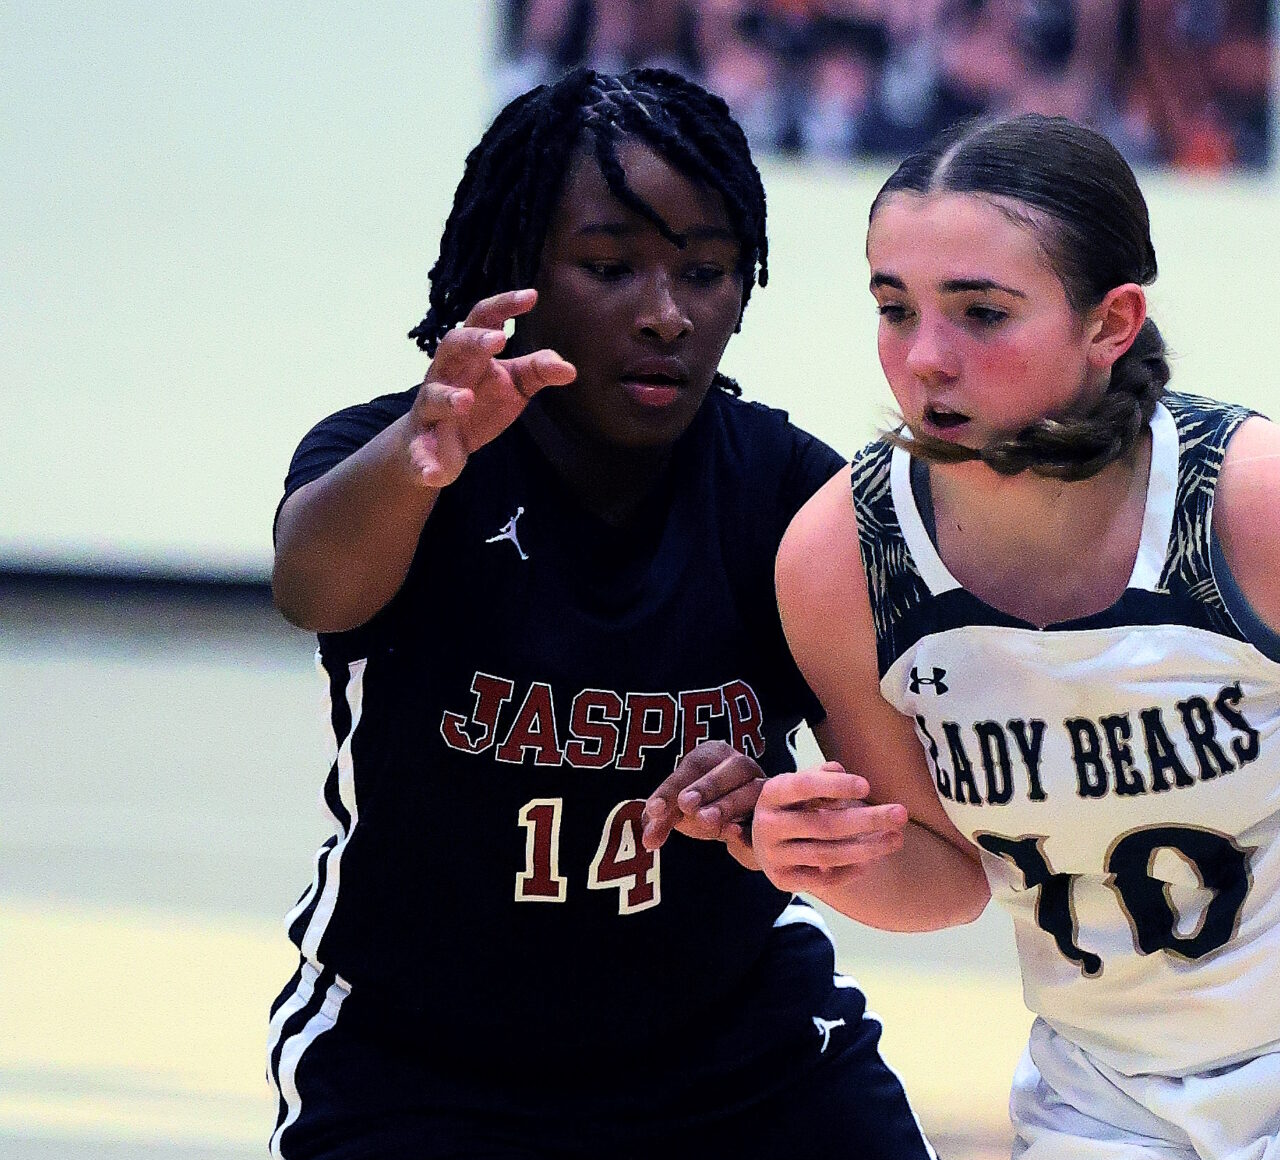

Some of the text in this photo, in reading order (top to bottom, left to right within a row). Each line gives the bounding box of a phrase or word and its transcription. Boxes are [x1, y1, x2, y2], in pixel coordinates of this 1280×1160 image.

[440, 671, 766, 770] JASPER
[914, 681, 1261, 807] LADY BEARS
[514, 796, 662, 916] 14
[971, 820, 1259, 978] 10
